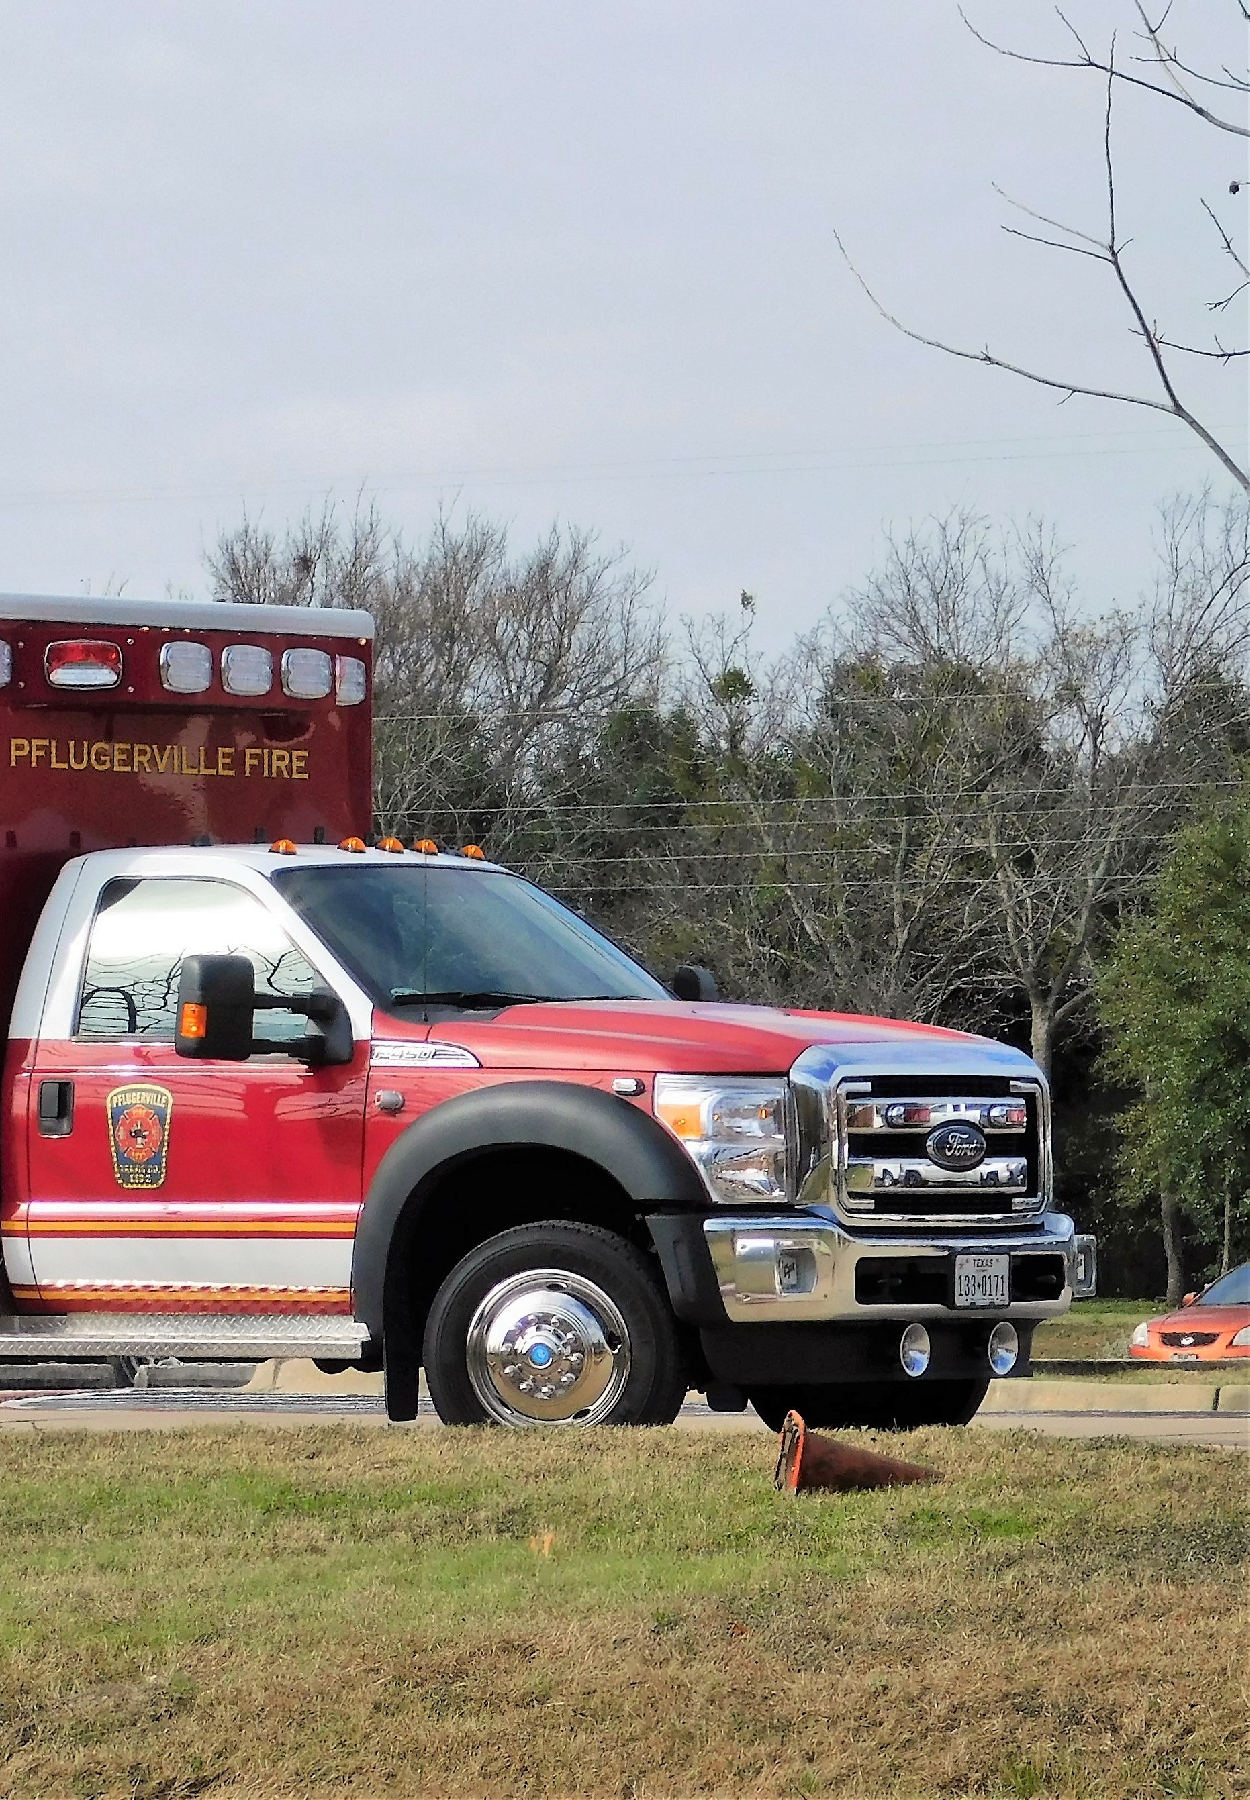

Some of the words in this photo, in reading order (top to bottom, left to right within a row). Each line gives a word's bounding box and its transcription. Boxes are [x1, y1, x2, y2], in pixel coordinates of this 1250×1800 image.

[9, 737, 237, 777] PFLUGERVILLE
[244, 747, 310, 780] FIRE
[112, 1091, 168, 1108] PFLUGERVILLE
[945, 1132, 979, 1156] Ford
[972, 1258, 994, 1268] TEXAS
